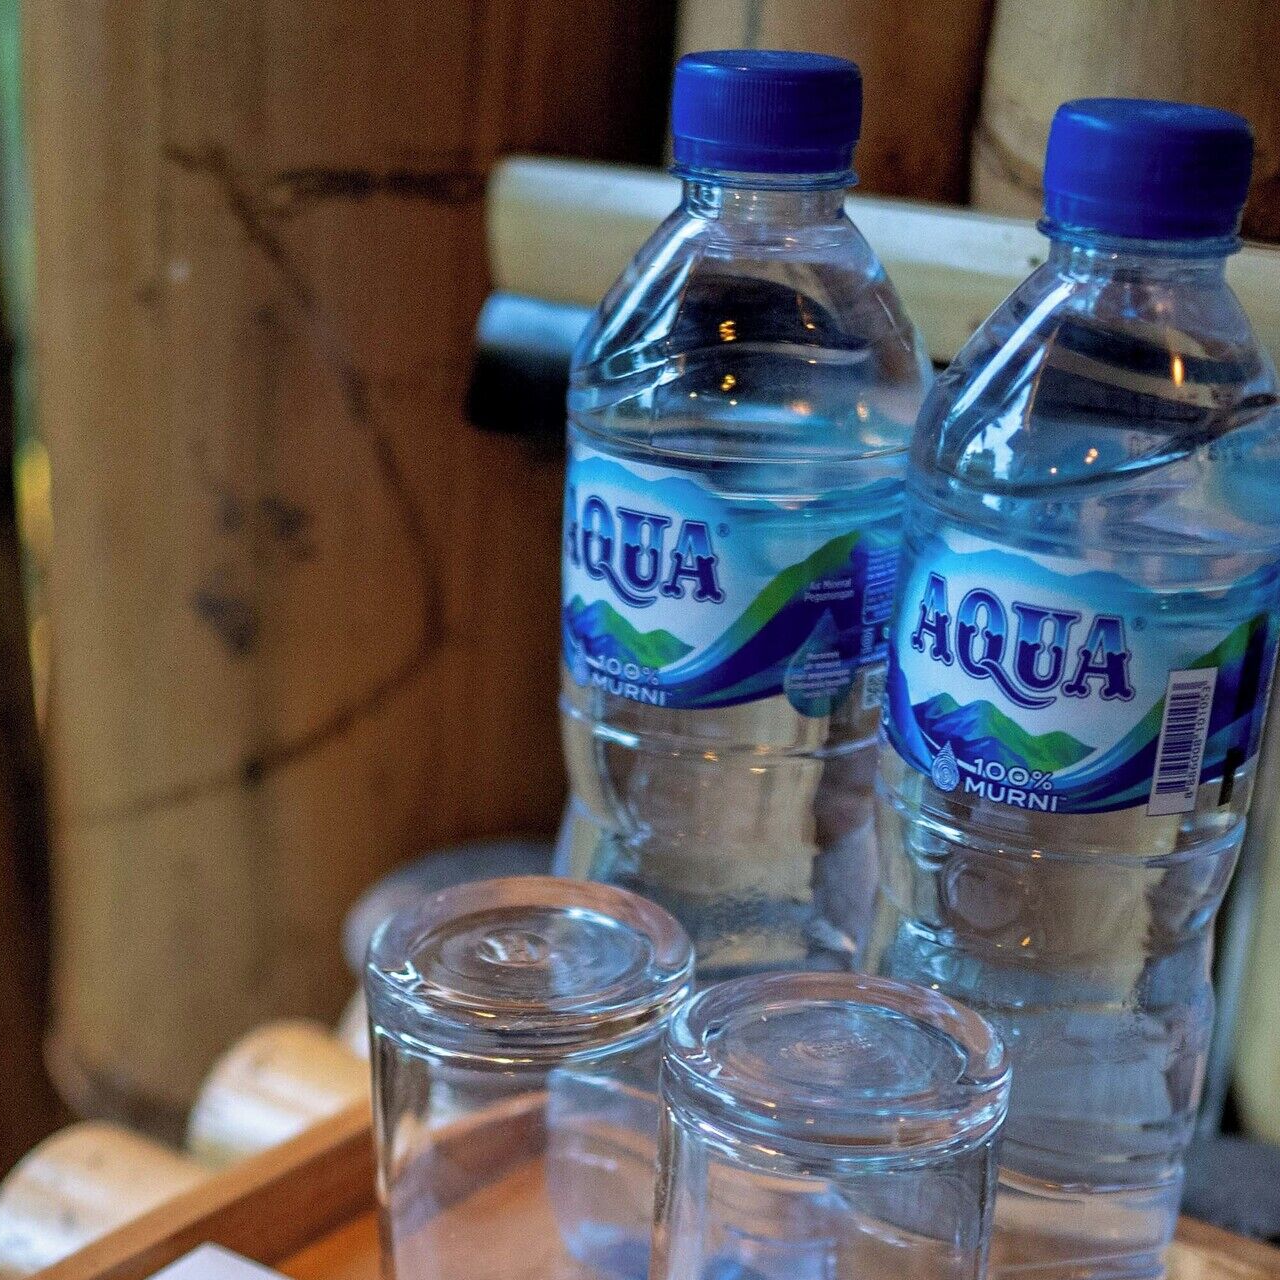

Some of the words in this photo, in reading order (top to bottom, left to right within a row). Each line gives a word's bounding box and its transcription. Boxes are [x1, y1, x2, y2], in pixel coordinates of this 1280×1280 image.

[912, 571, 1136, 709] AQUA
[591, 672, 666, 706] MURNI
[973, 758, 1054, 791] 100%
[963, 776, 1059, 813] MURNI
